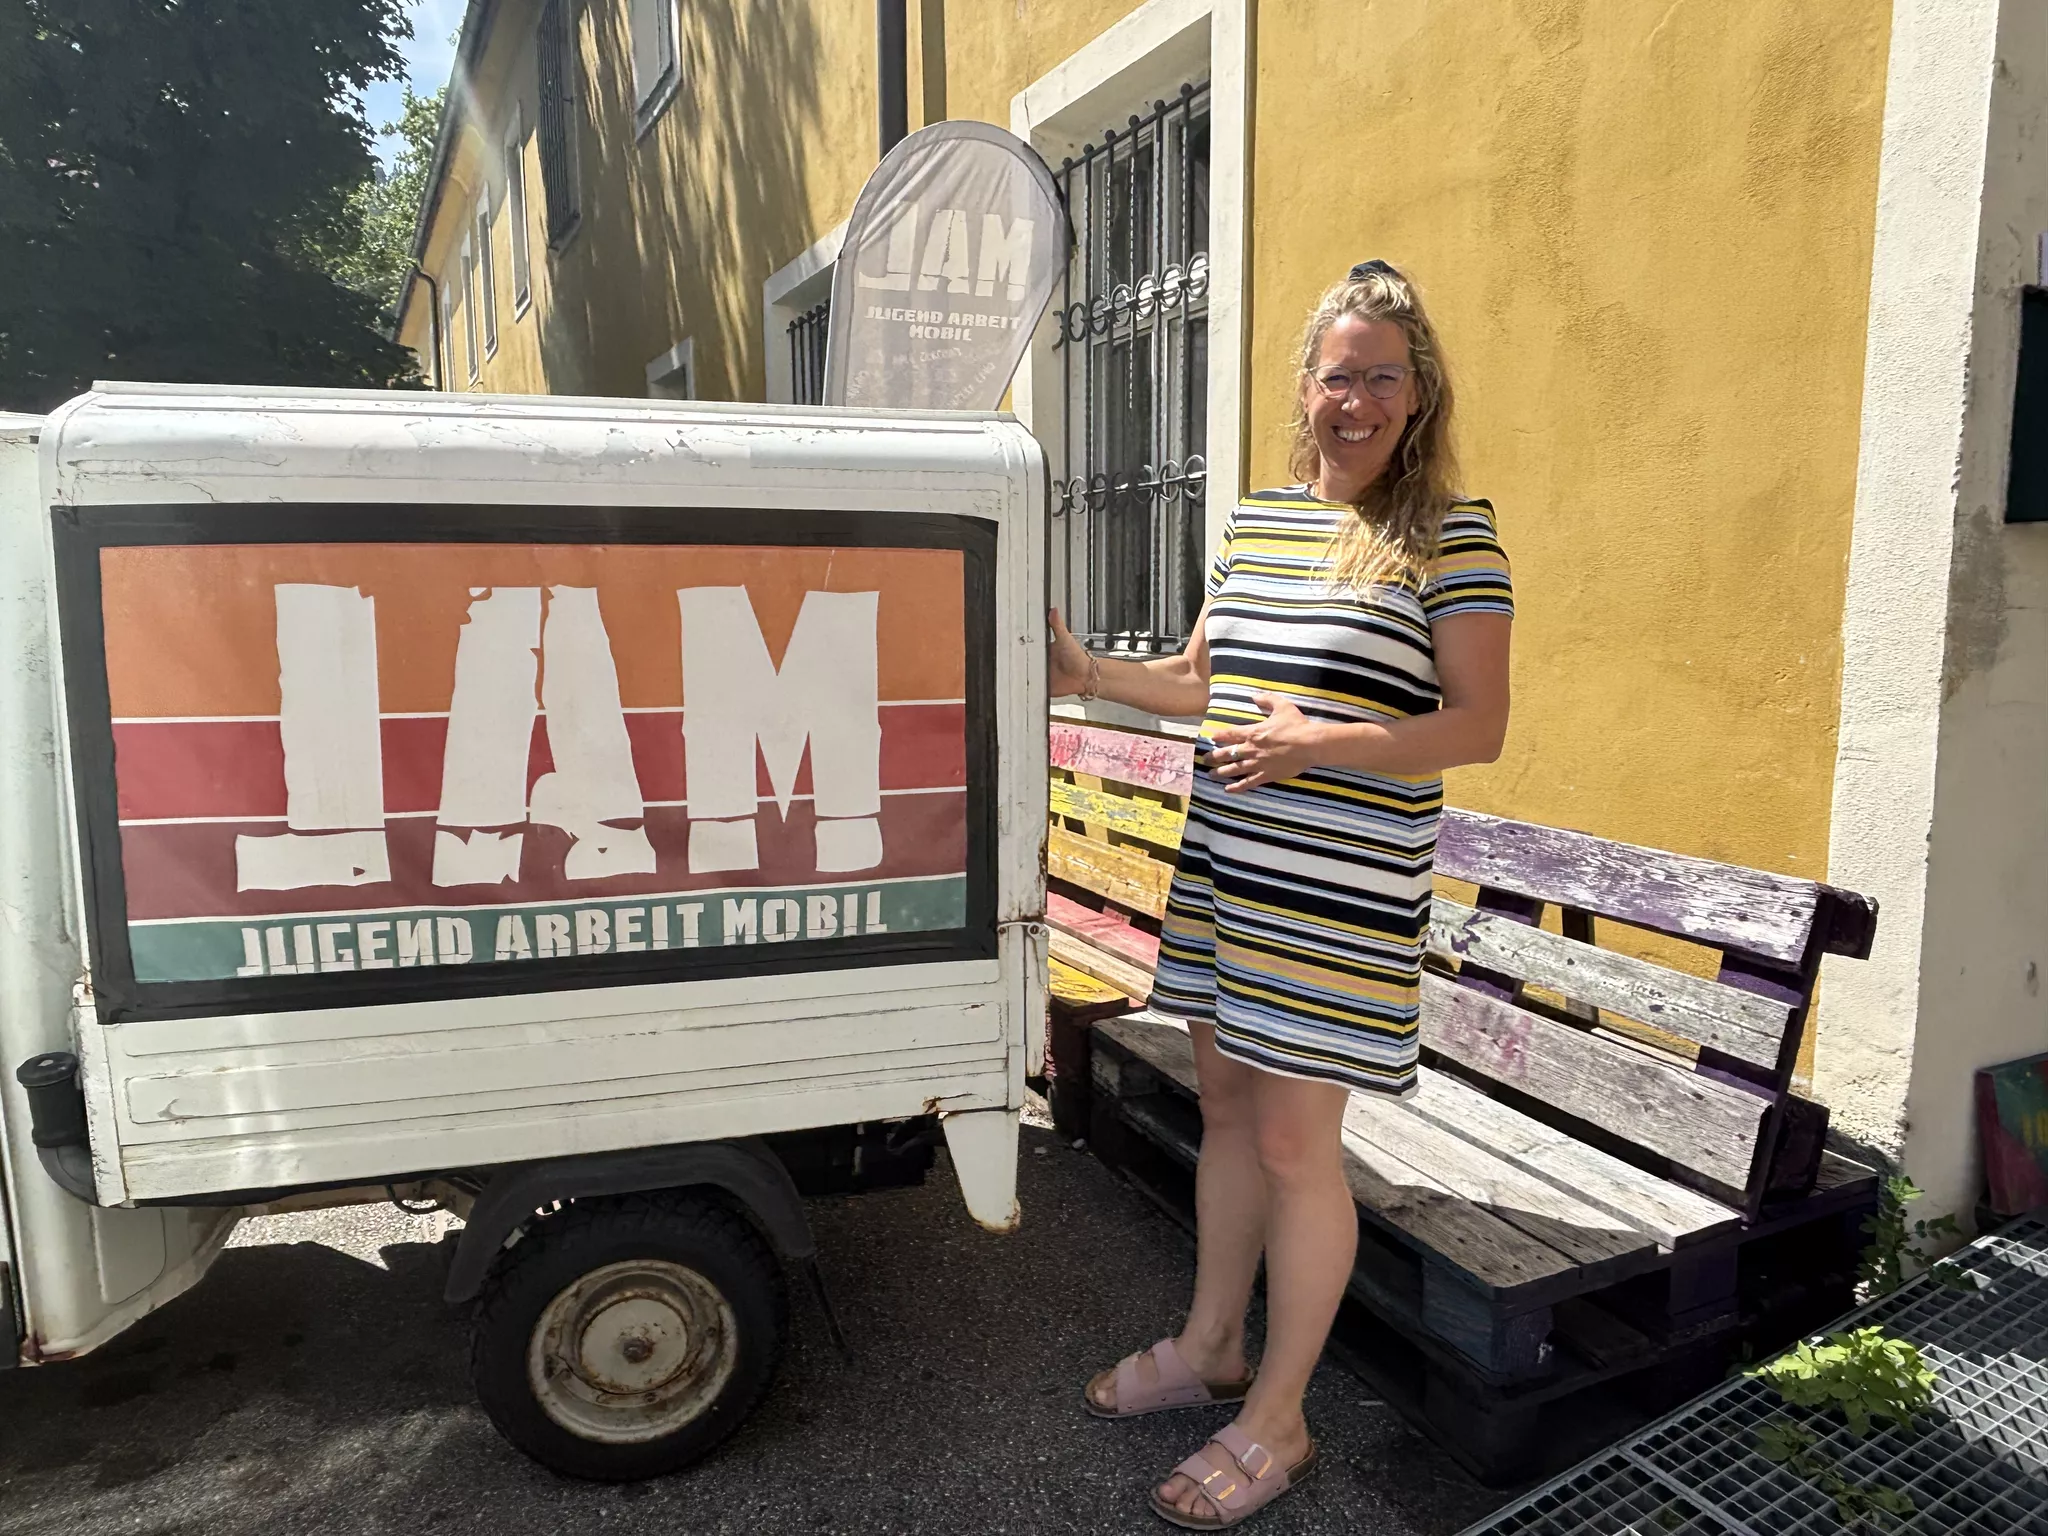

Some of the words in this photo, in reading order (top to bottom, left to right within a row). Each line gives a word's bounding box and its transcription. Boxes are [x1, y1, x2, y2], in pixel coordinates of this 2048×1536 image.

[858, 201, 1035, 301] JAM
[864, 305, 944, 324] JUGEND
[946, 312, 1021, 330] ARBEIT
[908, 324, 973, 341] MOBIL
[236, 583, 881, 893] JAM
[236, 916, 474, 977] JUGEND
[494, 902, 705, 961] ARBEIT
[722, 890, 888, 946] MOBIL
